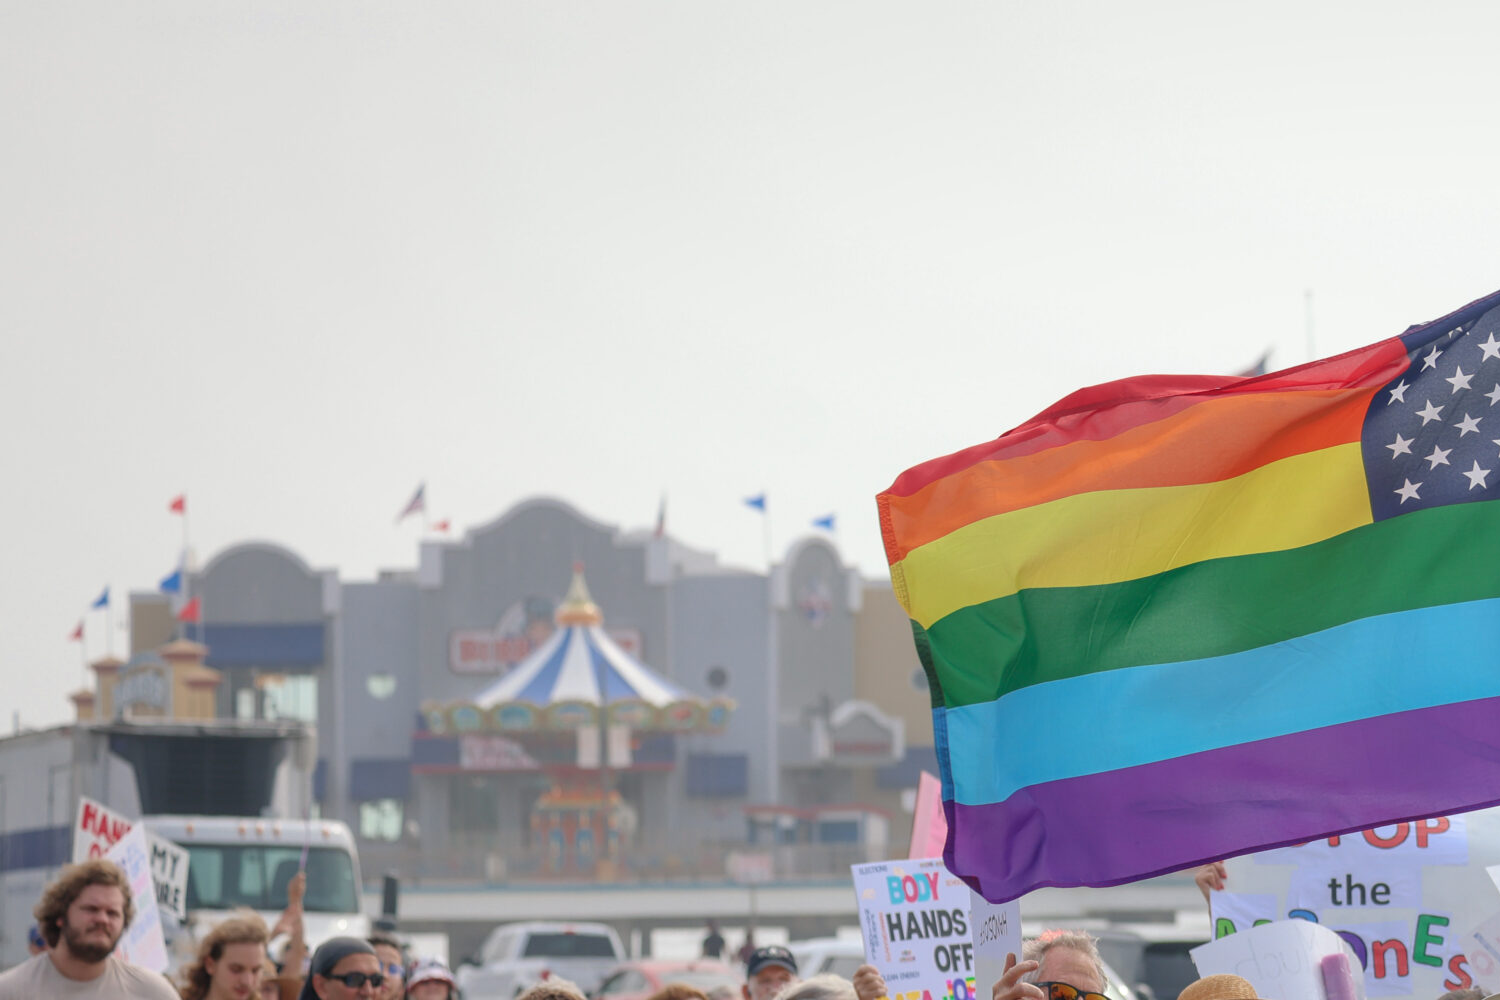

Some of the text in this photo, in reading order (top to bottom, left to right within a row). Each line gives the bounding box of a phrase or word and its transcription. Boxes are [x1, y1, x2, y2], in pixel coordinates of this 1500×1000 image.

[886, 871, 940, 905] BODY
[1327, 873, 1392, 906] the
[886, 908, 968, 942] HANDS
[934, 943, 974, 973] OFF
